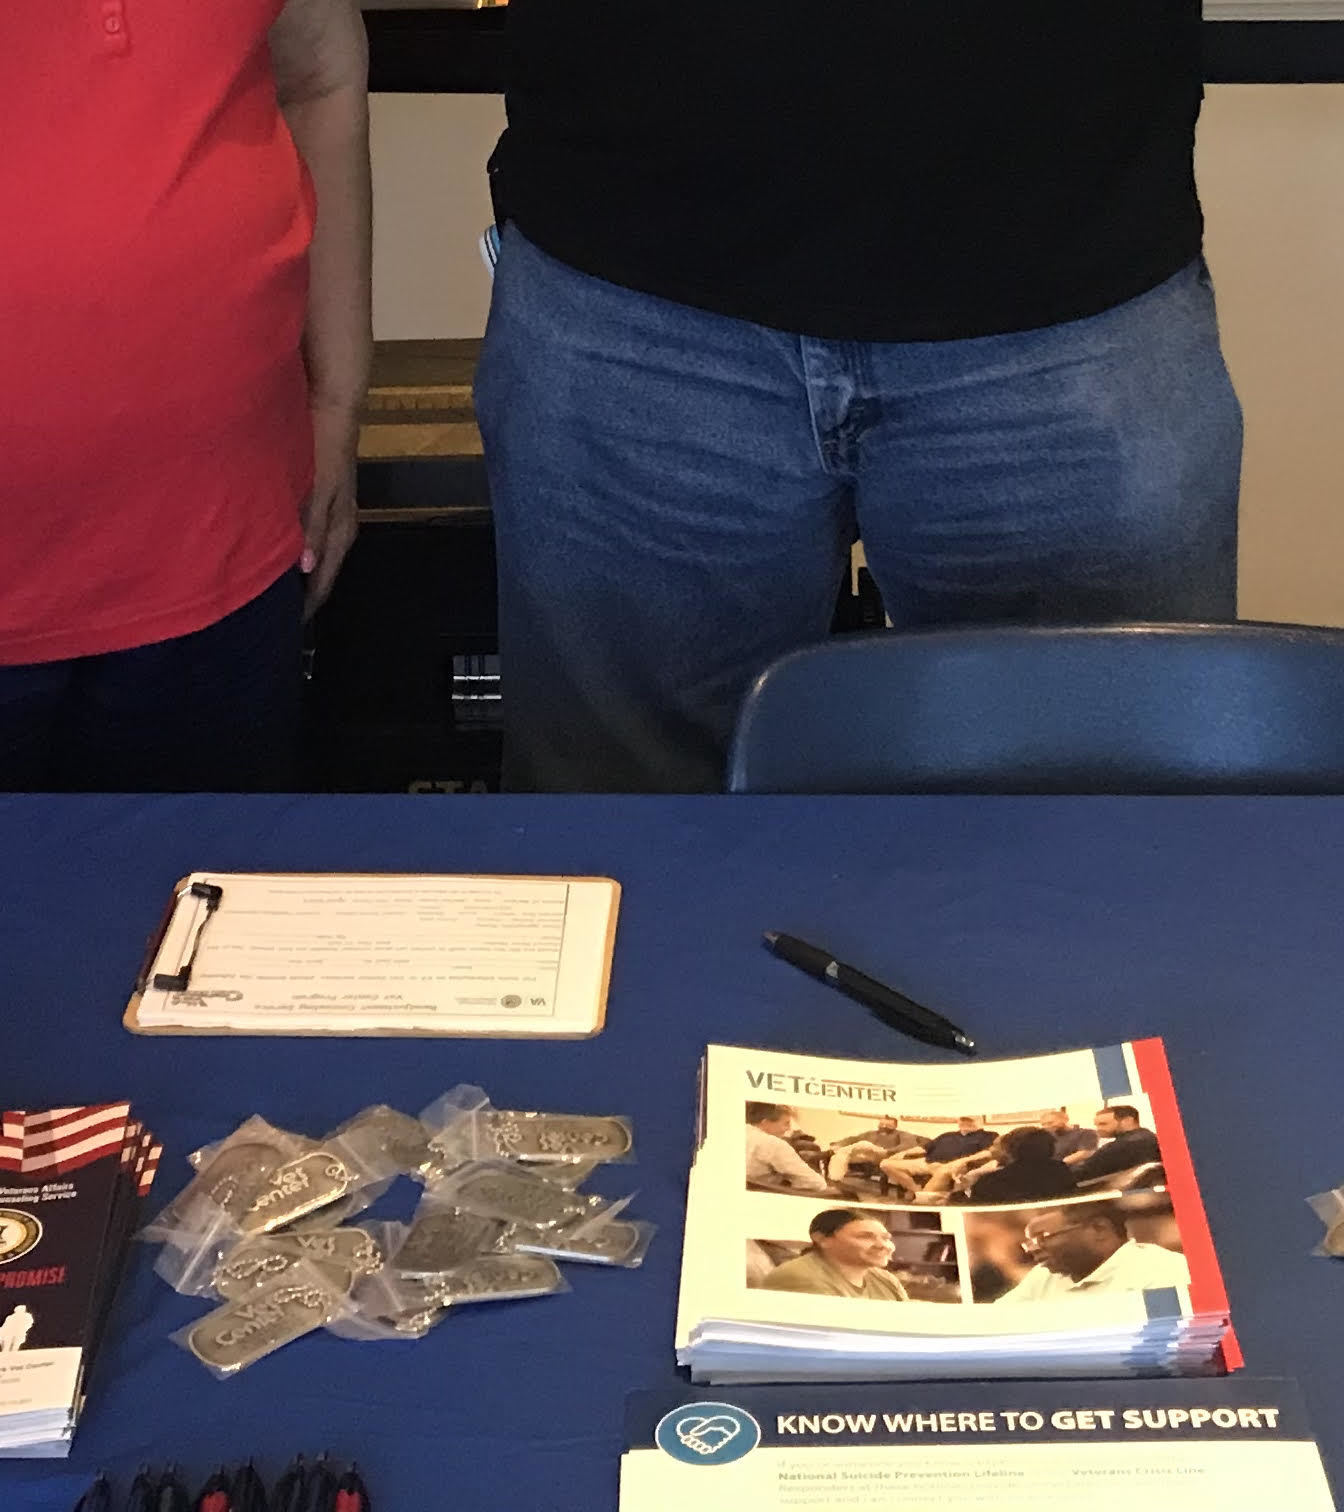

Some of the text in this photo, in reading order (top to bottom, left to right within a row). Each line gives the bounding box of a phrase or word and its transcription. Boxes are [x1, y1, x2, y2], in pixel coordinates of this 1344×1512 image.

[776, 1407, 1280, 1436] KNOW WHERE TO GET SUPPORT
[778, 1468, 1025, 1481] National Suicide Prevention Lifeline
